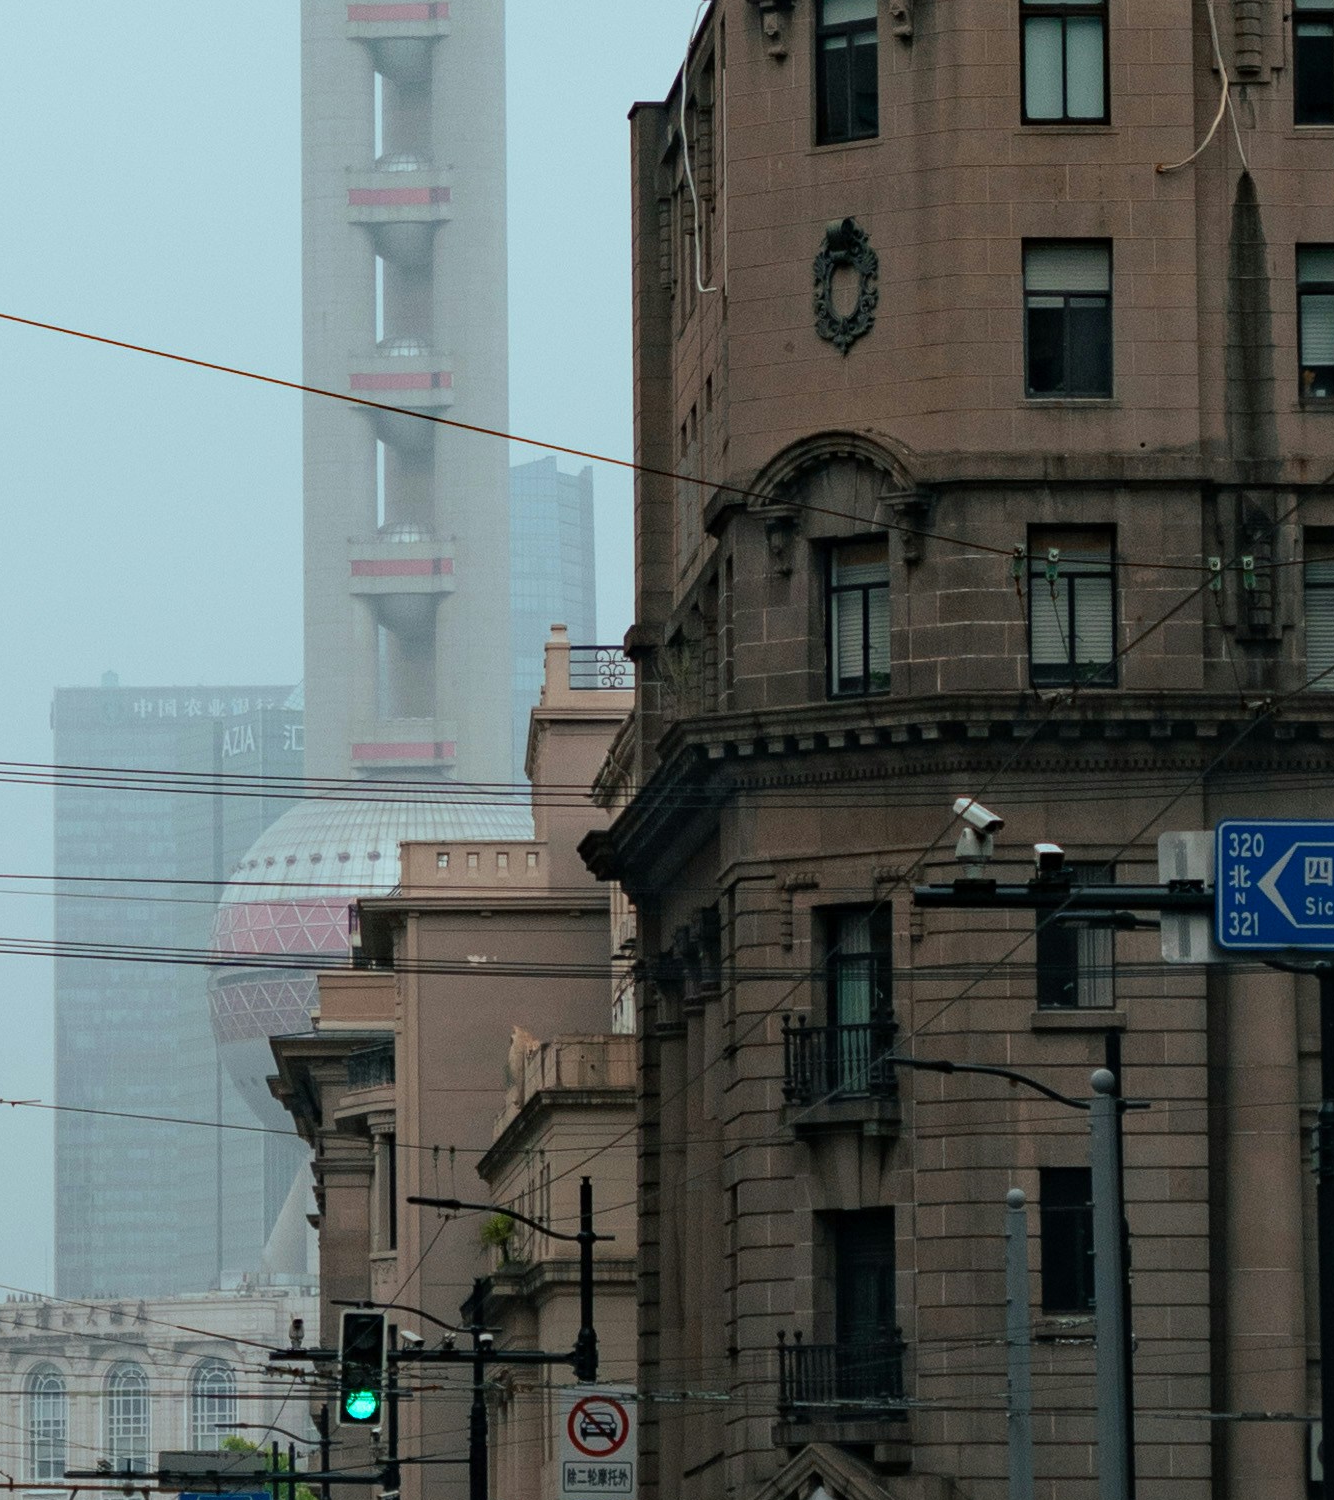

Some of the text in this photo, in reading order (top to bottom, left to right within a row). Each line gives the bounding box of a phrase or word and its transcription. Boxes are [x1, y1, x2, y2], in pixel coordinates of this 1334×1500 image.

[134, 698, 275, 718] 中国农业银行
[222, 724, 255, 758] AZIA
[1229, 833, 1264, 858] 320
[1229, 865, 1251, 889] 北
[1235, 892, 1246, 905] N
[1229, 912, 1260, 937] 321
[567, 1467, 629, 1488] 除二轮摩托外
